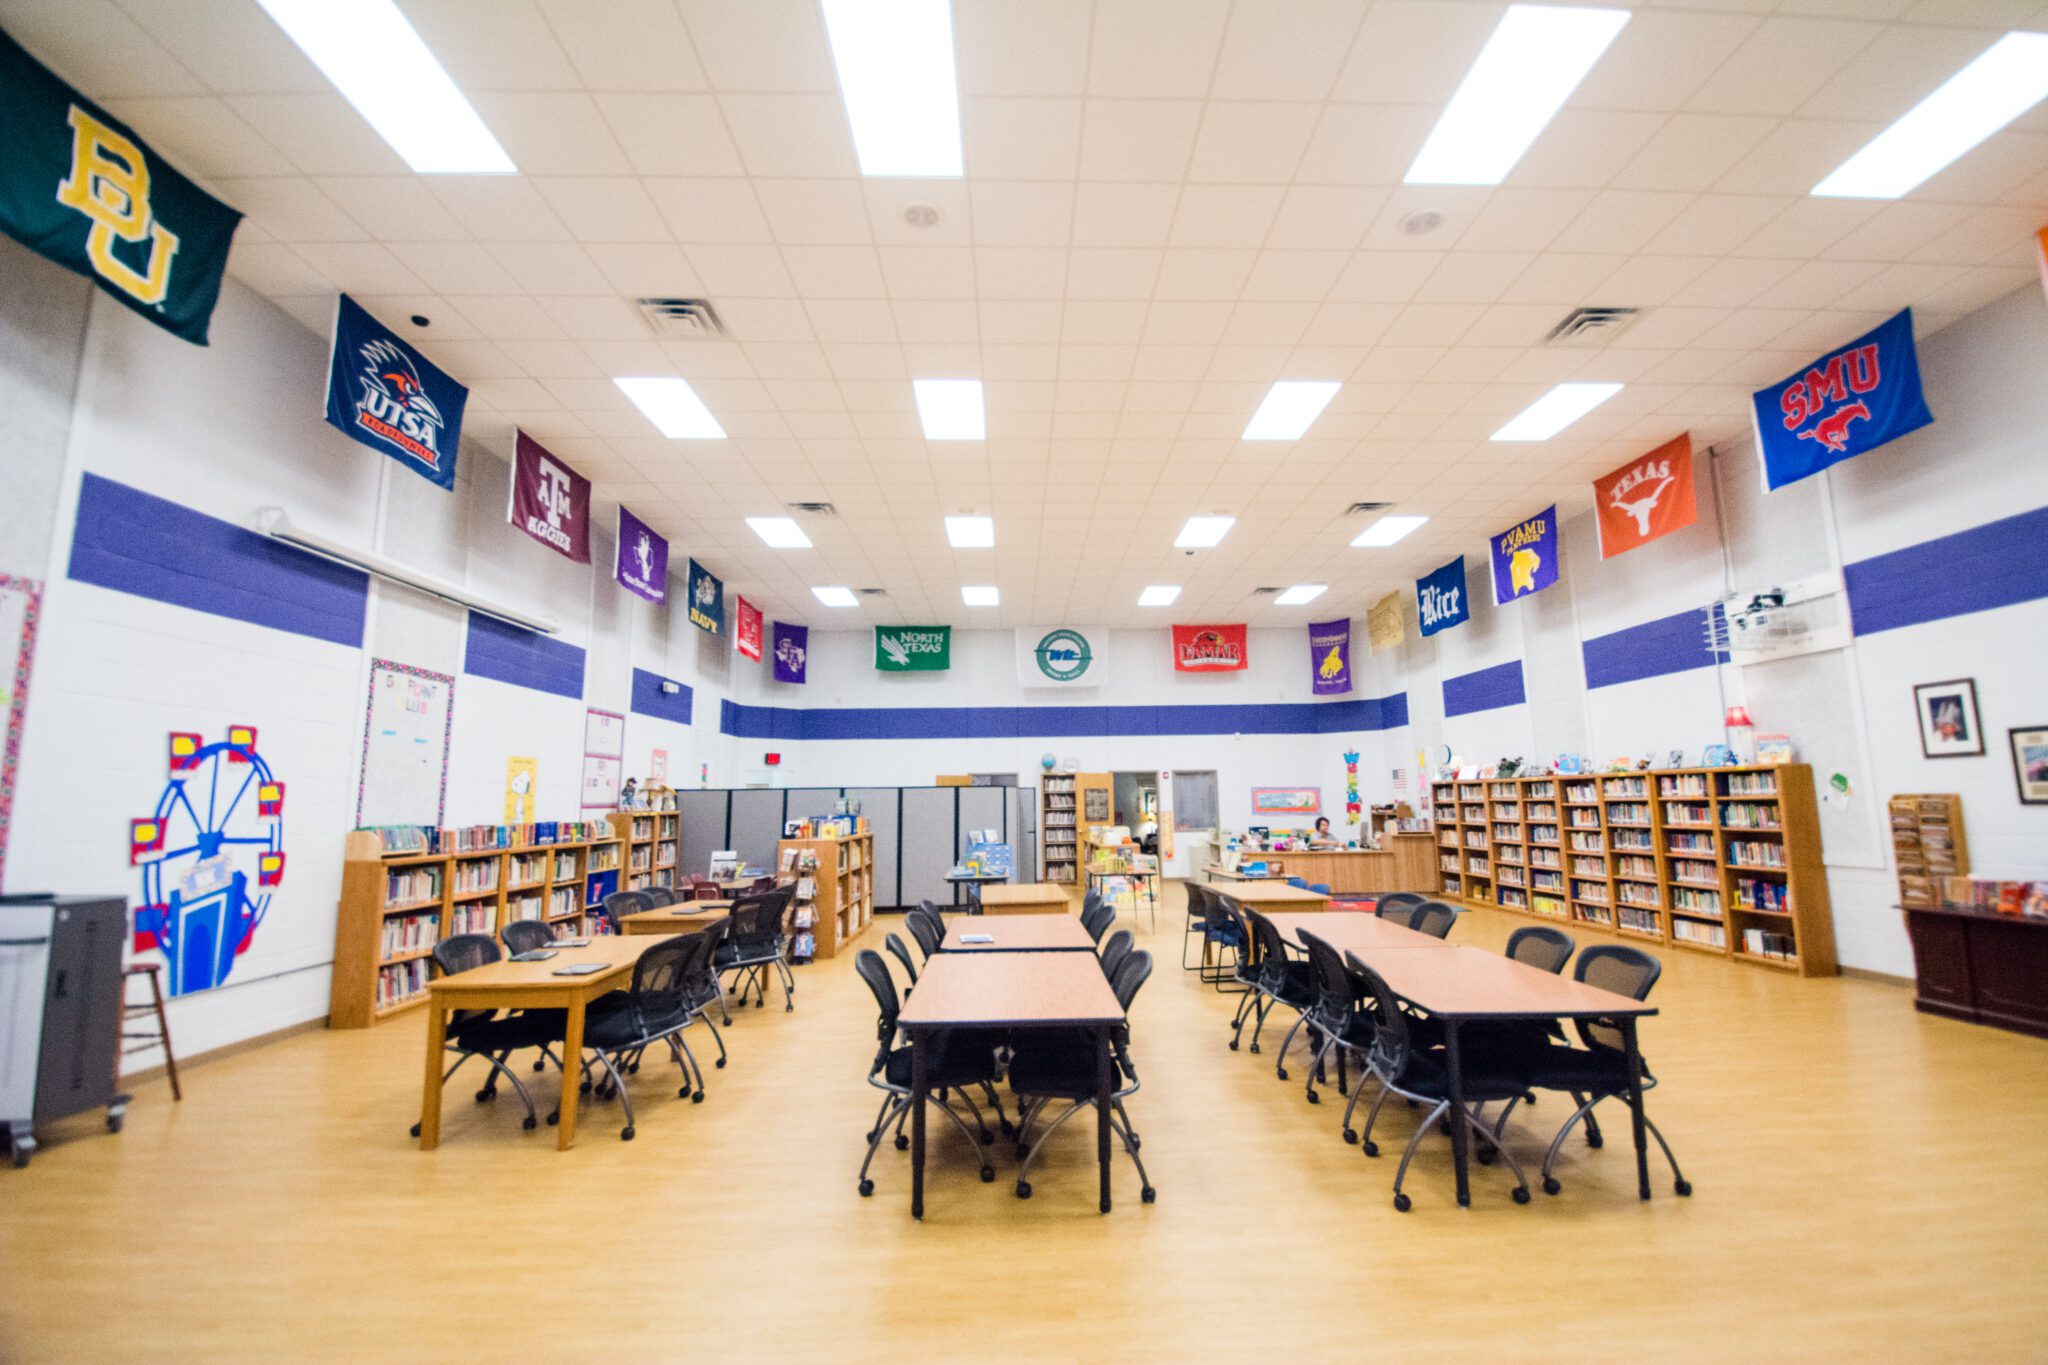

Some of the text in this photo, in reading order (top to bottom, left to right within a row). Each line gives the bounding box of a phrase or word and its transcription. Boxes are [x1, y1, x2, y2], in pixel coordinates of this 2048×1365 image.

[56, 103, 180, 304] BU
[1780, 343, 1880, 431] SMU
[367, 387, 434, 451] UTSA
[1611, 460, 1669, 502] TEXAS
[1501, 520, 1545, 555] PVAMU
[690, 607, 717, 634] NAVY
[1420, 585, 1459, 626] Rice
[900, 632, 944, 643] NORTH
[903, 642, 942, 654] TEXAS
[1180, 644, 1240, 660] LAMAR
